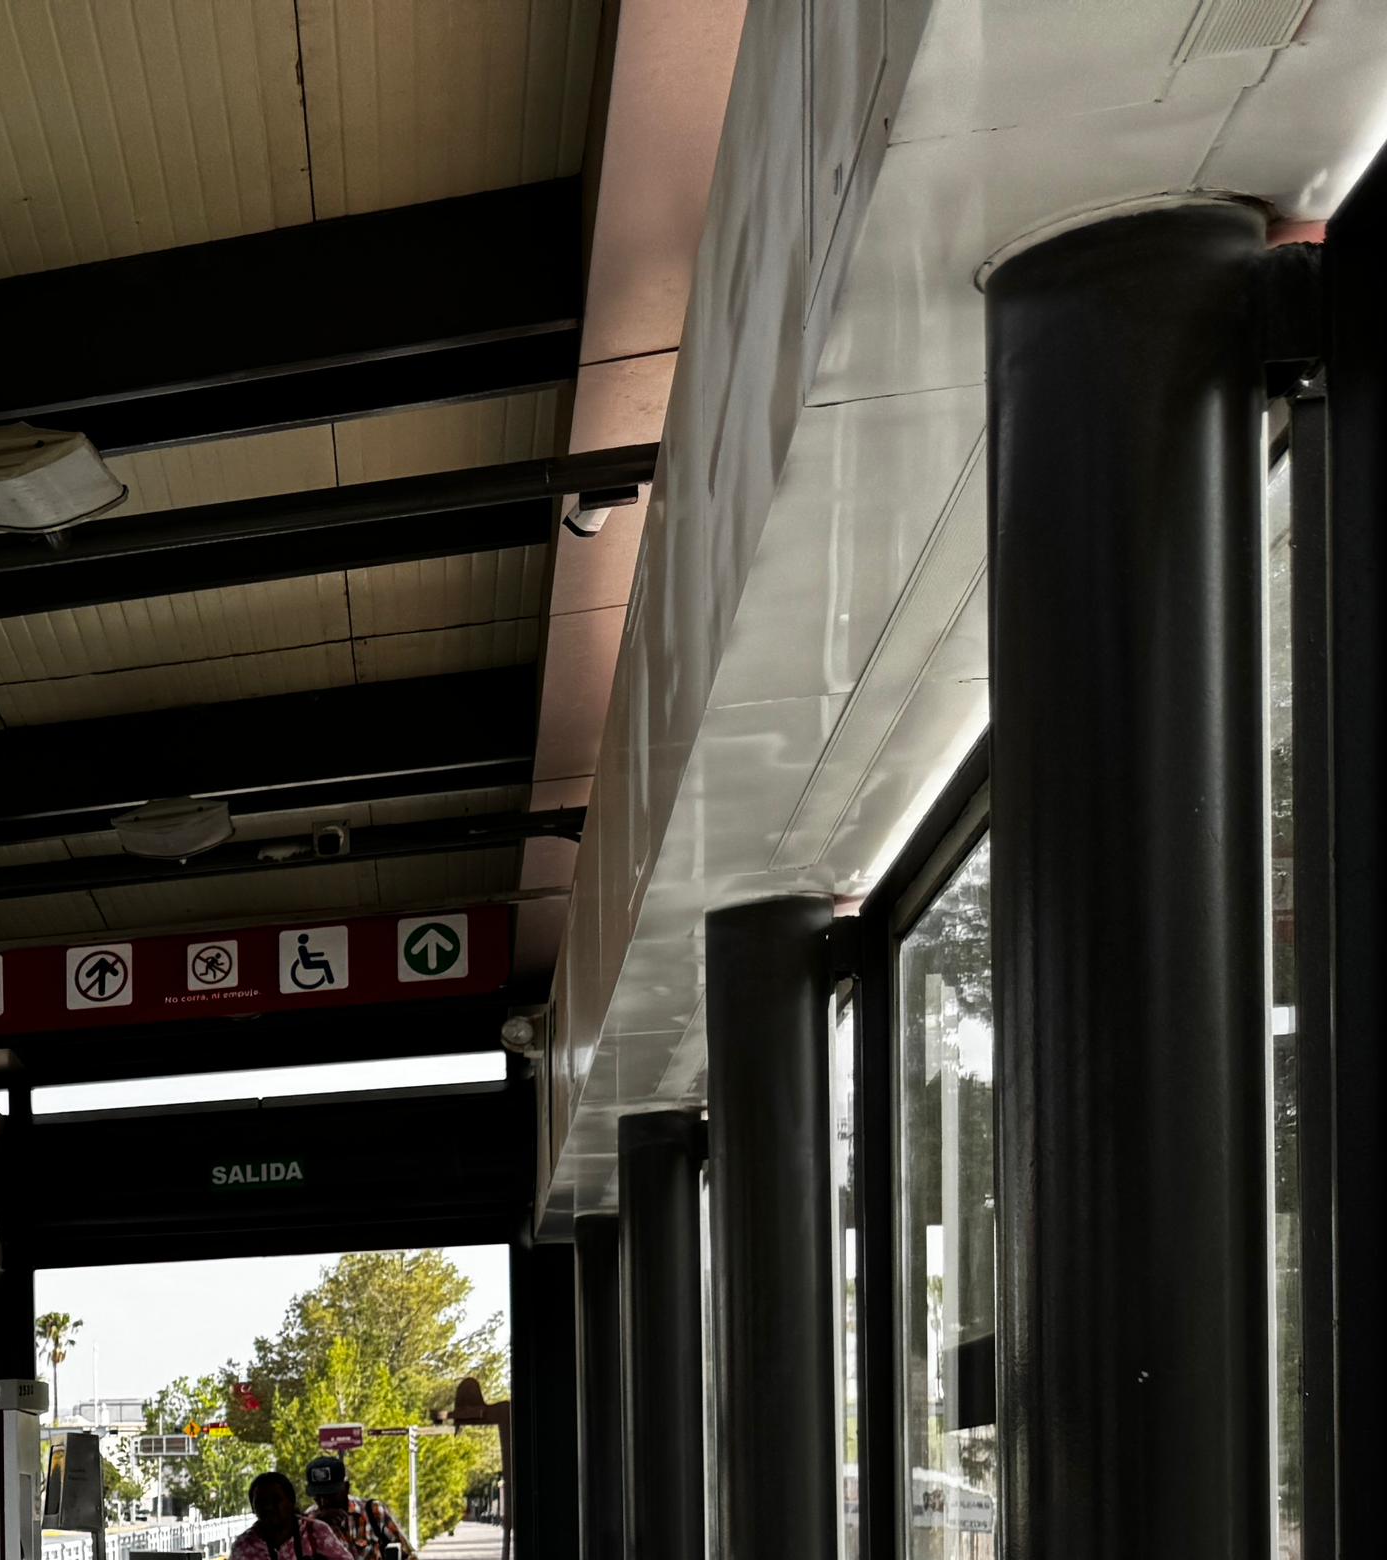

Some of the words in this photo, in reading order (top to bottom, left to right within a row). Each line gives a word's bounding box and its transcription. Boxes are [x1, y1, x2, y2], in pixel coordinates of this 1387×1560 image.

[164, 996, 178, 1004] No
[211, 992, 220, 1000] ni
[212, 1161, 303, 1185] SALIDA
